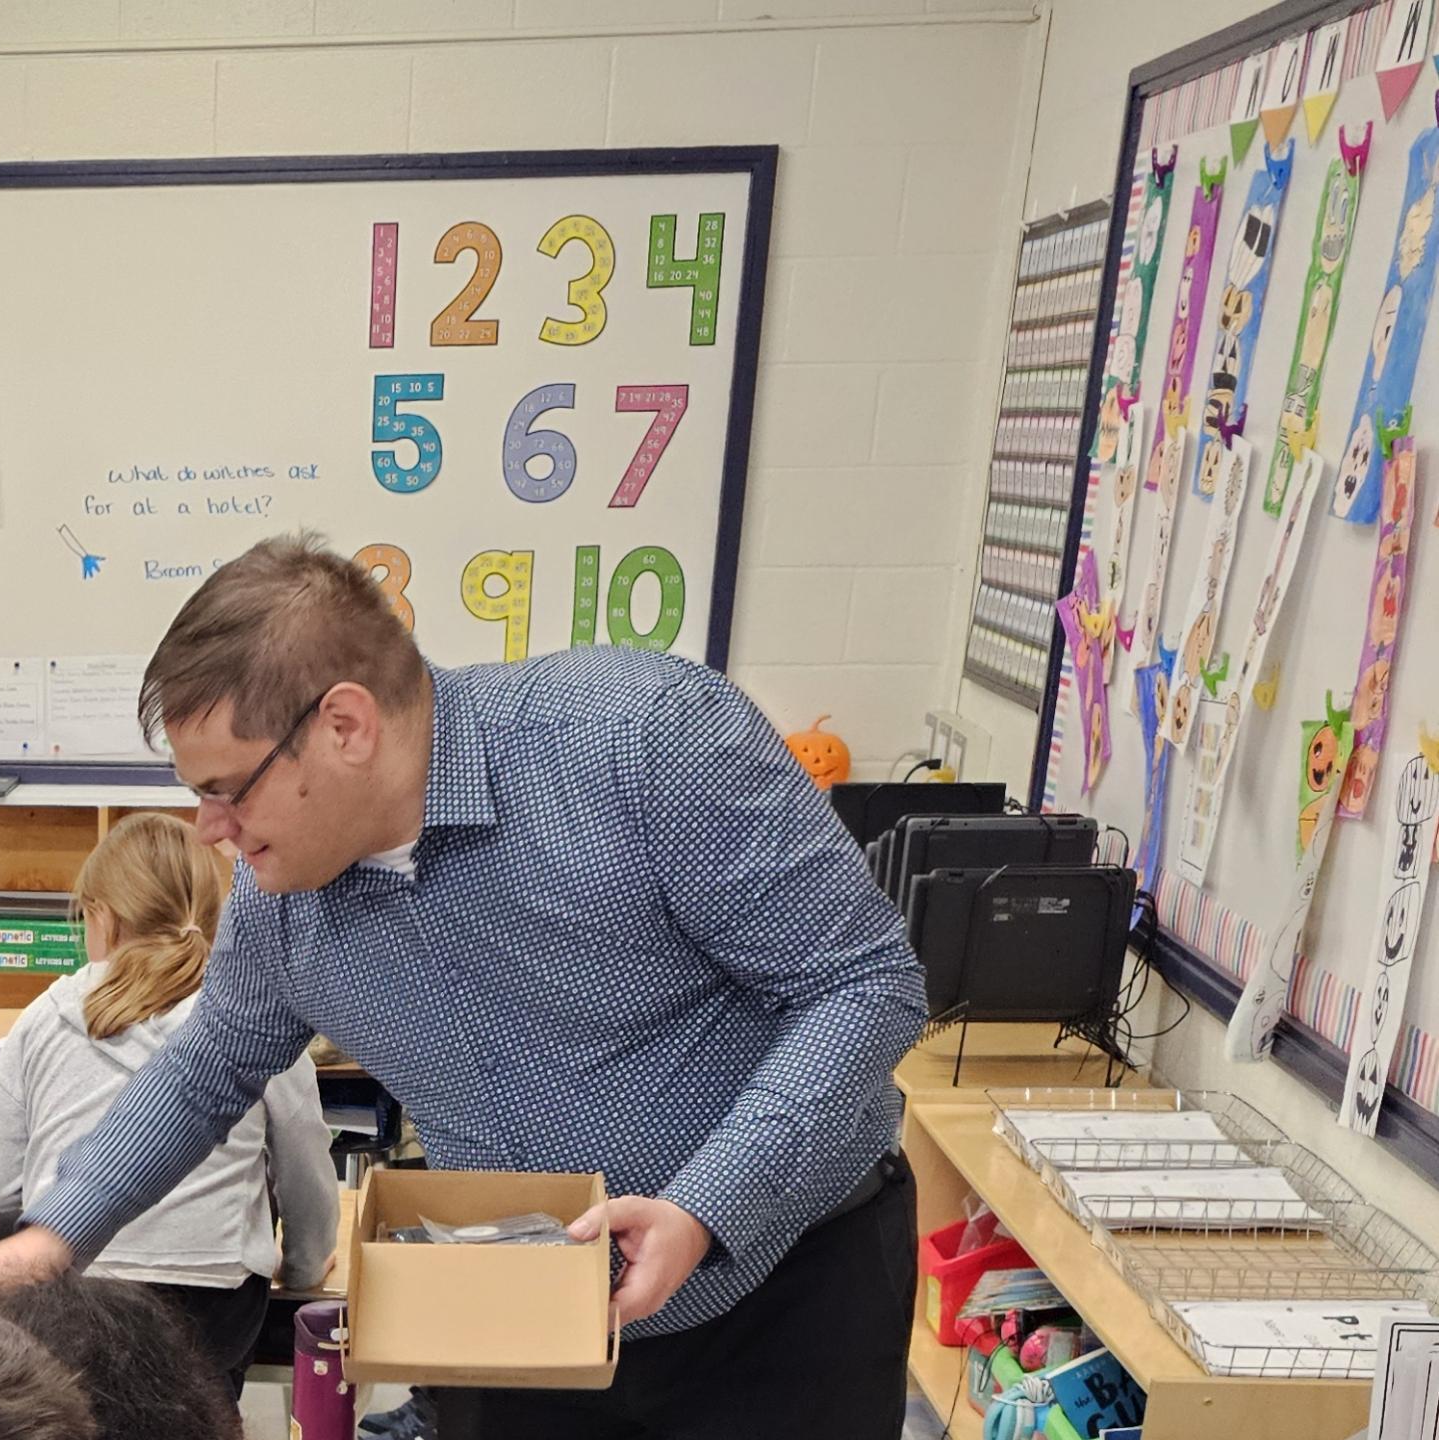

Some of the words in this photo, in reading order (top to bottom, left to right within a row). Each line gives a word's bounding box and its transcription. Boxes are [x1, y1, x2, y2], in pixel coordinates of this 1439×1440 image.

[369, 222, 399, 349] 1
[430, 221, 503, 347] 2
[537, 214, 615, 346] 3
[646, 212, 725, 346] 4
[371, 373, 445, 493] 5
[392, 383, 401, 393] 15
[409, 383, 421, 392] 10
[427, 383, 434, 392] 5
[502, 383, 576, 503] 6
[607, 384, 690, 507] 7
[84, 495, 114, 516] for
[133, 498, 158, 515] at
[178, 501, 191, 515] a
[207, 495, 272, 518] hotel?
[177, 465, 197, 482] do
[203, 462, 274, 481] witches
[289, 464, 321, 480] ask
[144, 560, 202, 580] Broom
[460, 549, 535, 664] 9
[571, 544, 686, 653] 10
